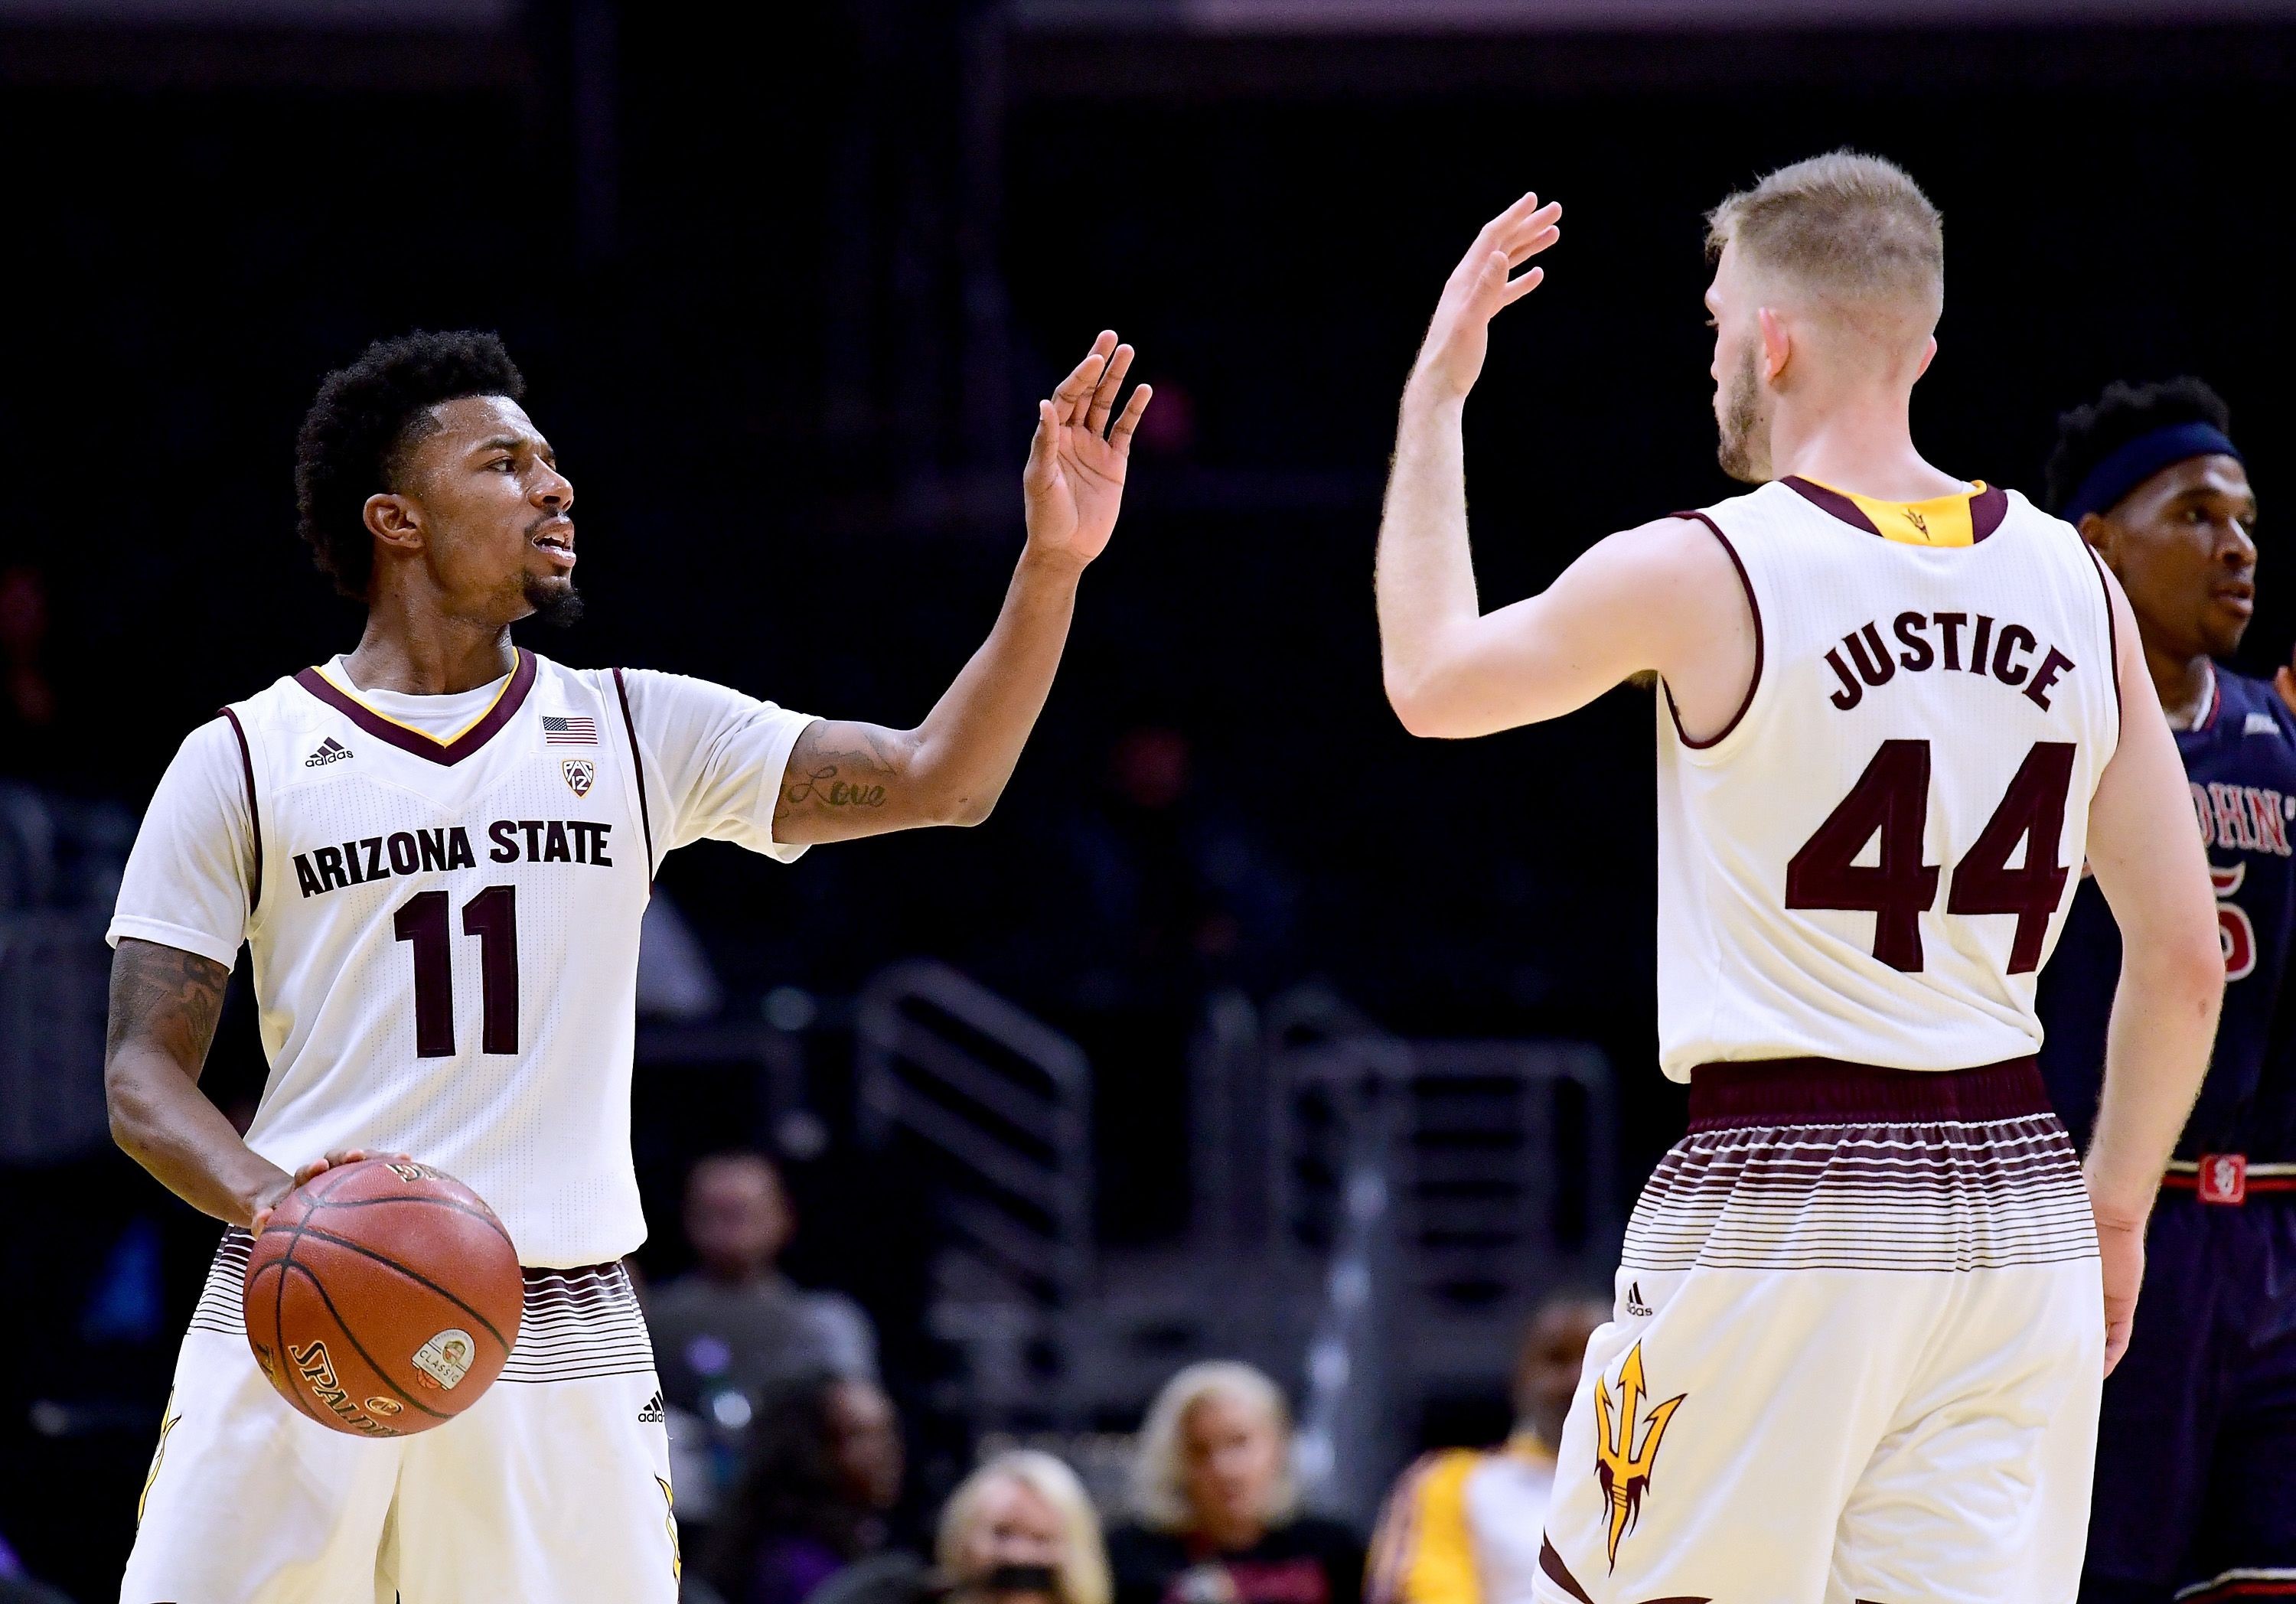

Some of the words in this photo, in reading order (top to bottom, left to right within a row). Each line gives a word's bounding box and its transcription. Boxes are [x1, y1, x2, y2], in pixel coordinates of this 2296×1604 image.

[1823, 611, 2076, 712] JUSTICE
[305, 750, 354, 768] adidas
[563, 760, 593, 783] PAC
[571, 775, 589, 791] 12
[788, 765, 886, 807] Love
[292, 826, 477, 899] ARIZONA
[488, 820, 613, 868] STATE
[1785, 738, 2078, 976] 44
[393, 884, 520, 1059] 11
[419, 1349, 459, 1383] CLASSIC
[638, 1410, 665, 1423] adid
